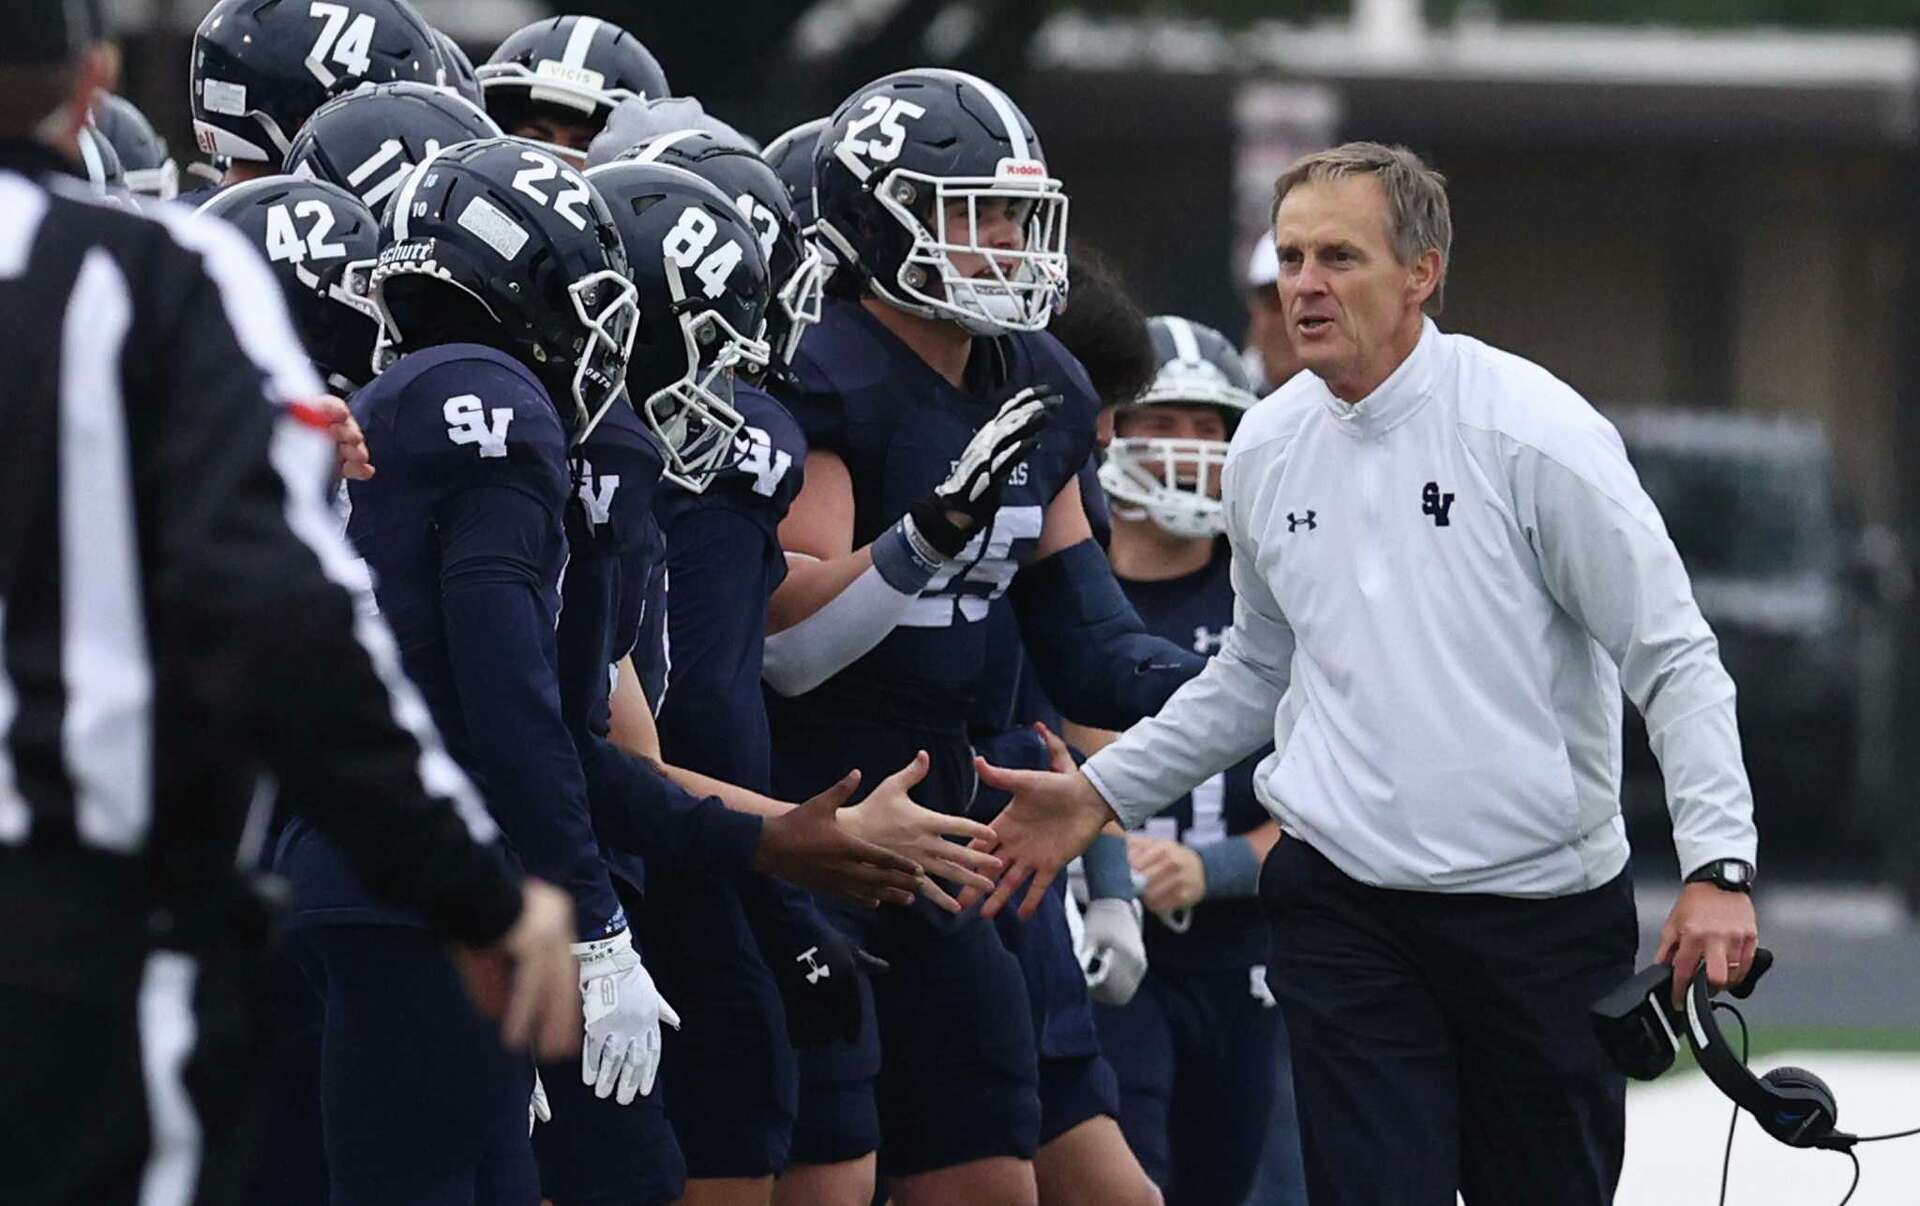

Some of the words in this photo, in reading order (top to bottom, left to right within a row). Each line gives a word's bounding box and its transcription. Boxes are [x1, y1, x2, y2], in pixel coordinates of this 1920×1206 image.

[309, 1, 376, 76] 74
[843, 95, 927, 163] 25
[510, 151, 591, 231] 22
[265, 199, 347, 264] 42
[662, 206, 744, 300] 84
[443, 393, 514, 458] SV
[1422, 481, 1455, 527] SV
